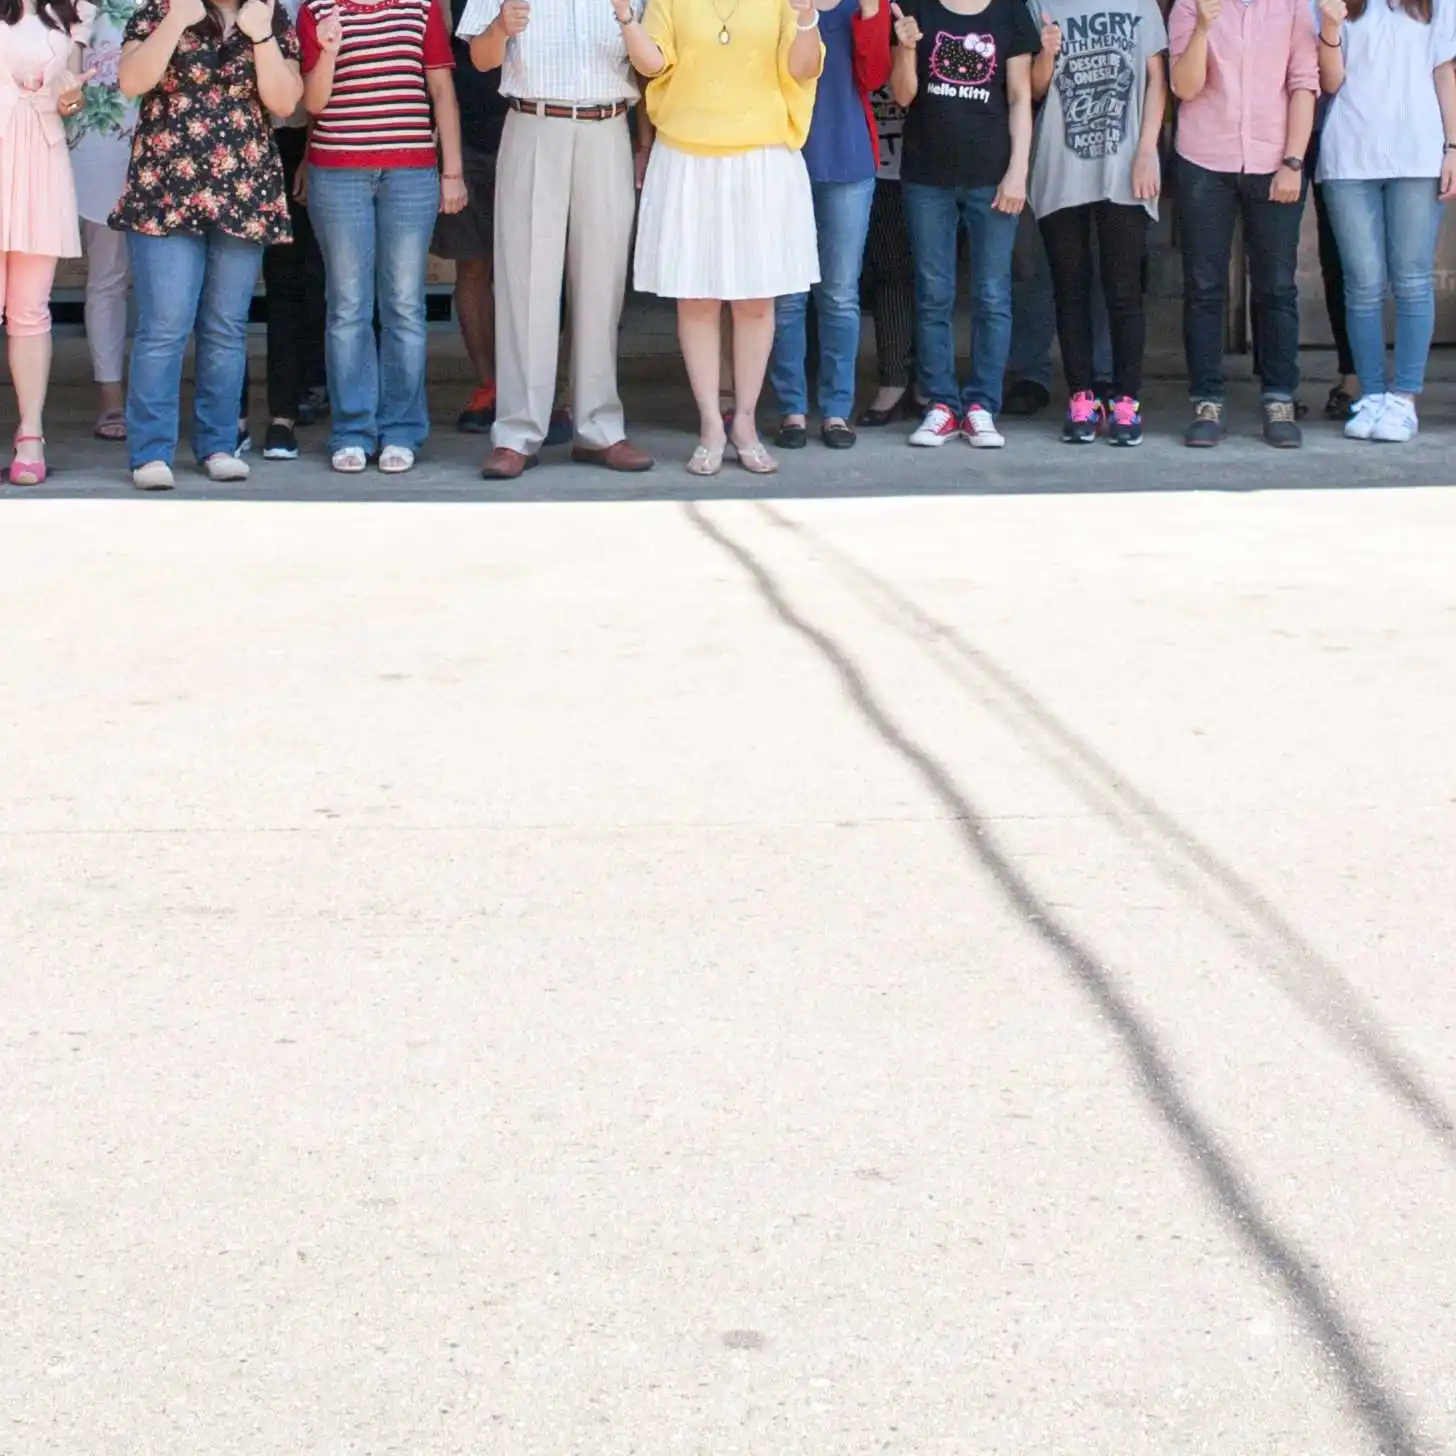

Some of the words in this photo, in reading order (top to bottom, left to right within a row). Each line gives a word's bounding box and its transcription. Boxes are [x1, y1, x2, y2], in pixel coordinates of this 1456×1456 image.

[1054, 11, 1142, 41] NGRY
[927, 83, 957, 97] Hello
[959, 85, 991, 104] Kitty
